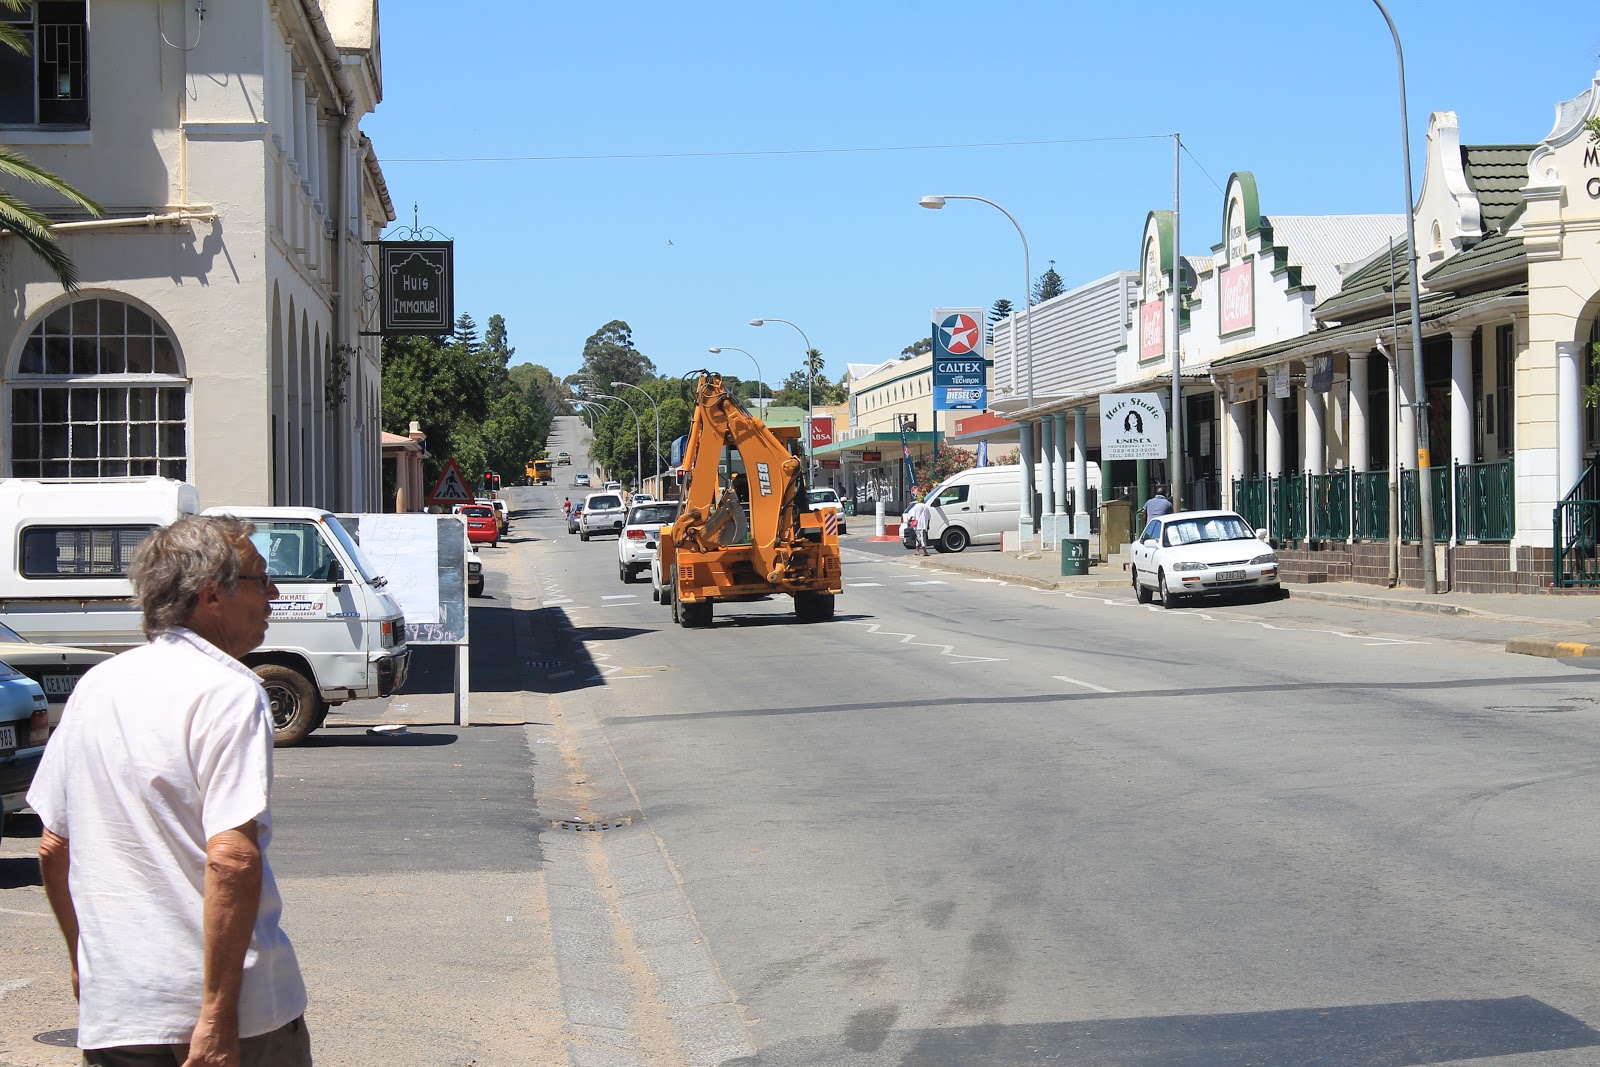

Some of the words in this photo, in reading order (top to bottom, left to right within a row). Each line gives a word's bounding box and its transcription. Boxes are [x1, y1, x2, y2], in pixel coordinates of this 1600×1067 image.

[403, 274, 428, 290] Huis
[938, 363, 980, 373] CALTEX
[947, 391, 969, 400] DIESEL
[1105, 401, 1126, 420] Hair
[1130, 397, 1160, 420] Studio
[811, 433, 832, 441] ABSA
[756, 462, 772, 497] BELL
[46, 678, 61, 692] CEA
[62, 677, 80, 692] 1145
